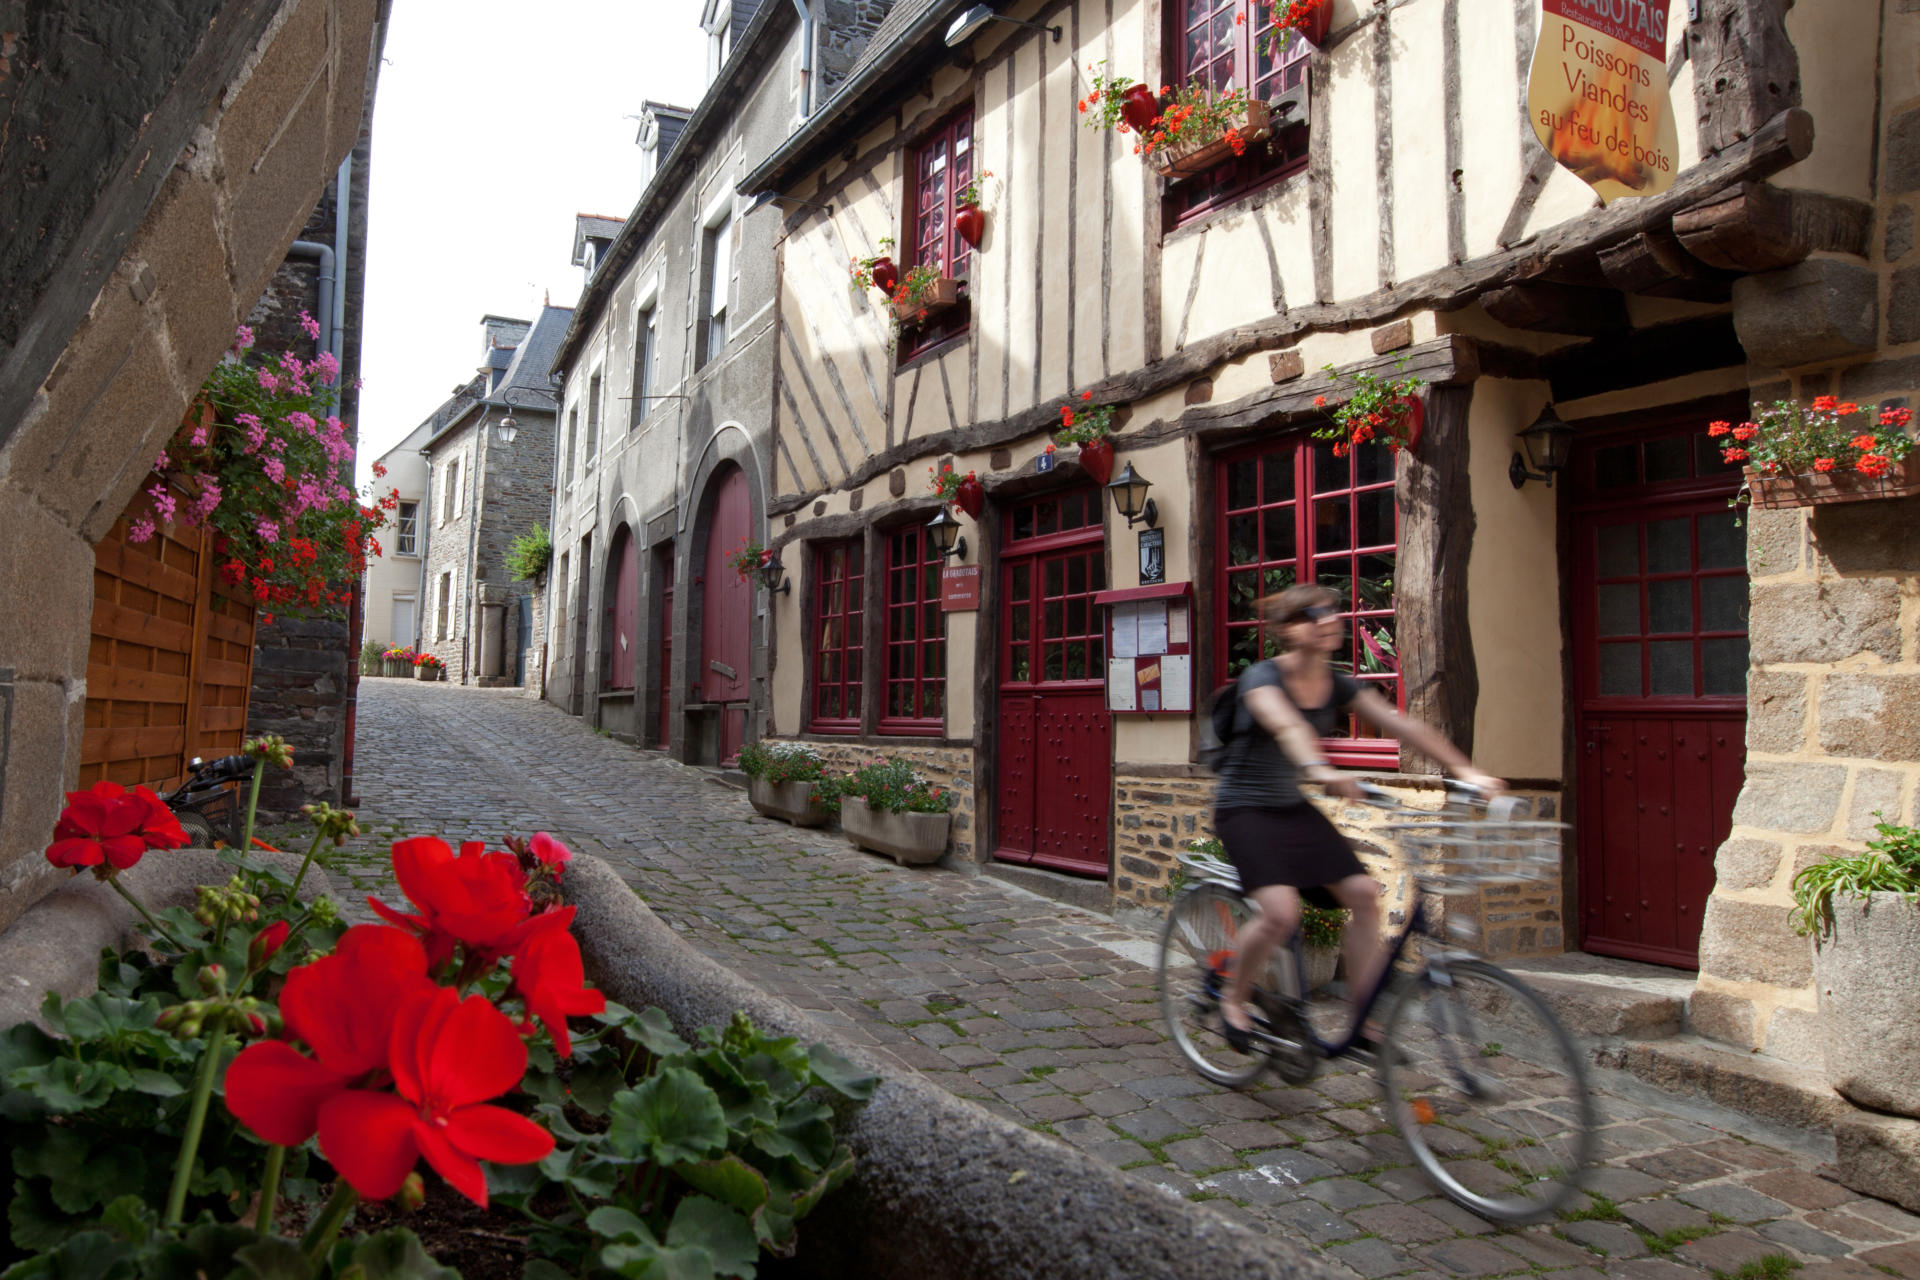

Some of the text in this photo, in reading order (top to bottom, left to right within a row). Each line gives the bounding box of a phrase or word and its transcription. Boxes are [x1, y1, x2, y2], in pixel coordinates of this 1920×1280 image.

[1561, 3, 1604, 32] Restaurant
[1604, 21, 1614, 35] du
[1574, 0, 1665, 43] BOTAIS
[1562, 24, 1650, 87] Poissons
[1562, 61, 1649, 122] Viandes
[1540, 109, 1670, 172] au feu de bois
